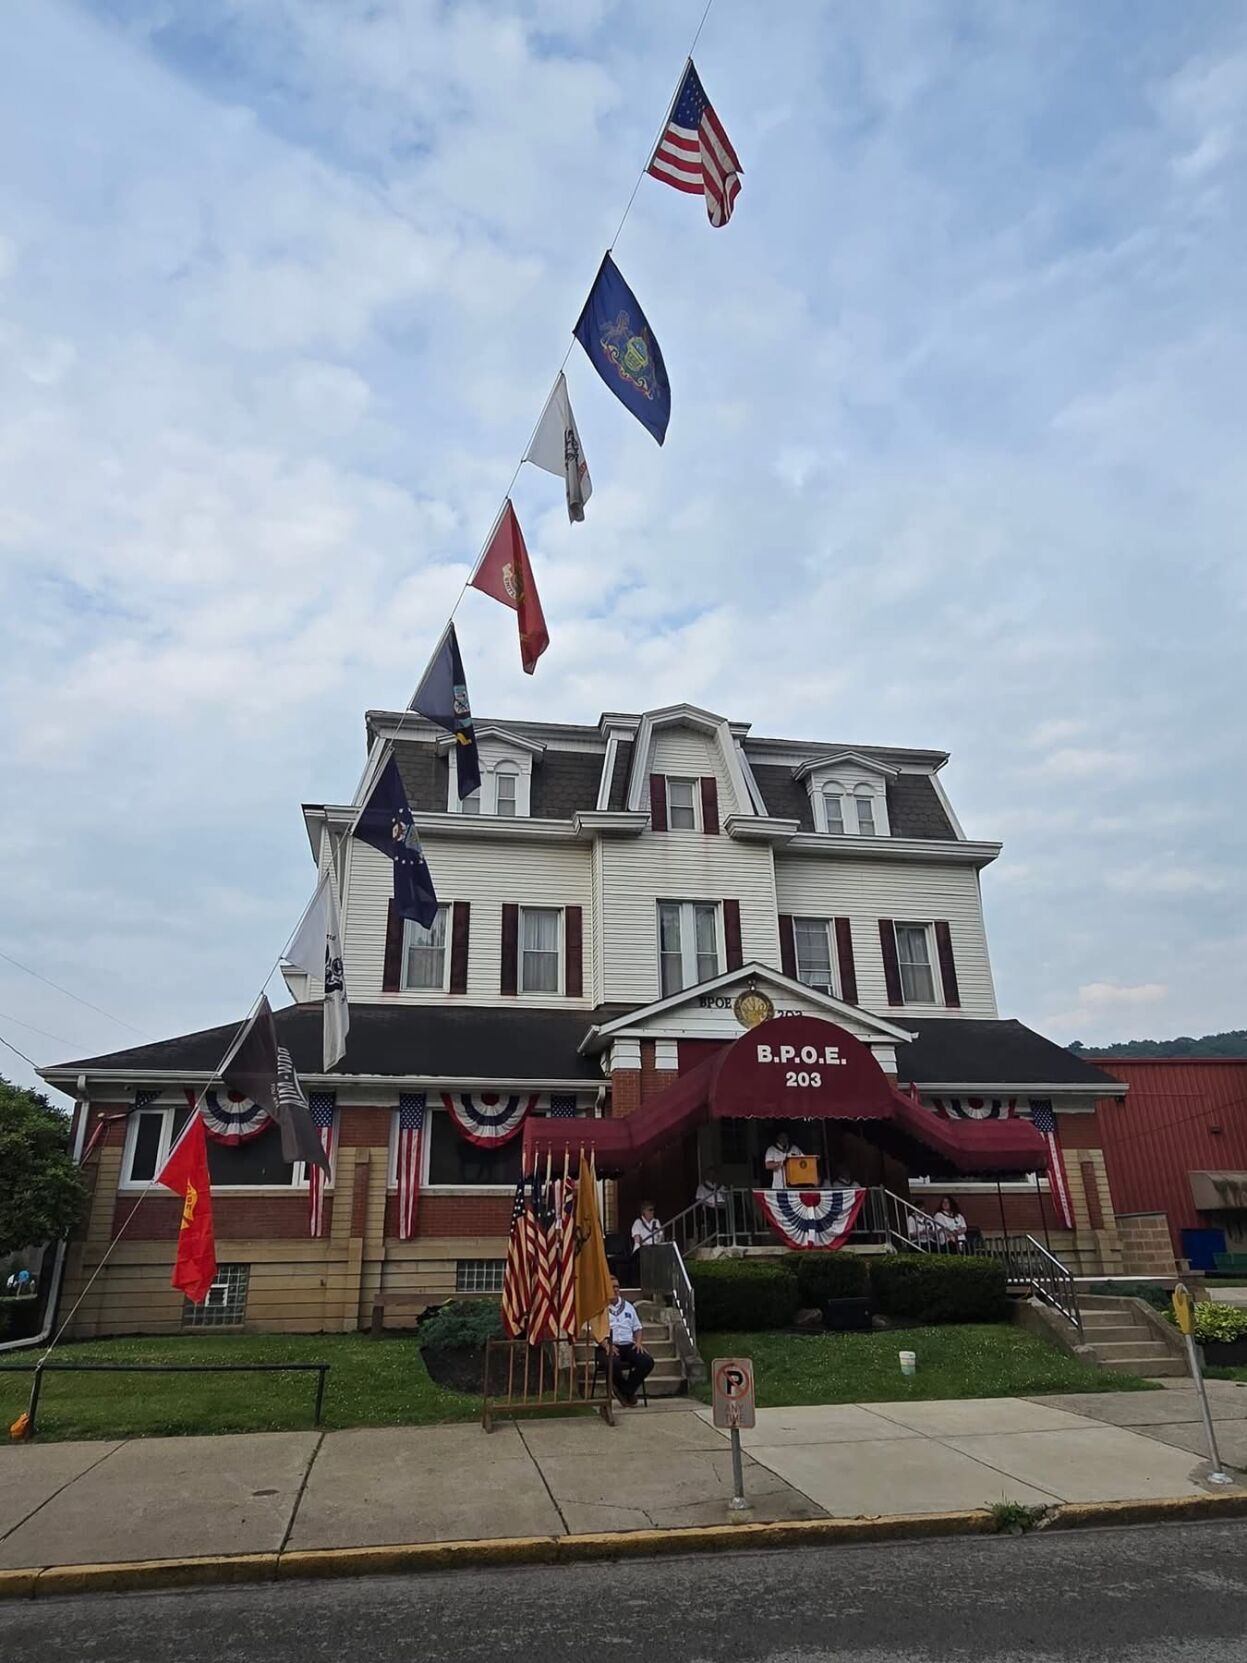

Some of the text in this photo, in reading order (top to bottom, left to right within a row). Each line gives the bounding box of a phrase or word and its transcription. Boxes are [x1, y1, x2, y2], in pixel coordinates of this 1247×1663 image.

[699, 996, 732, 1009] BPOE
[757, 1045, 847, 1065] B.P.O.E.
[786, 1071, 822, 1087] 203
